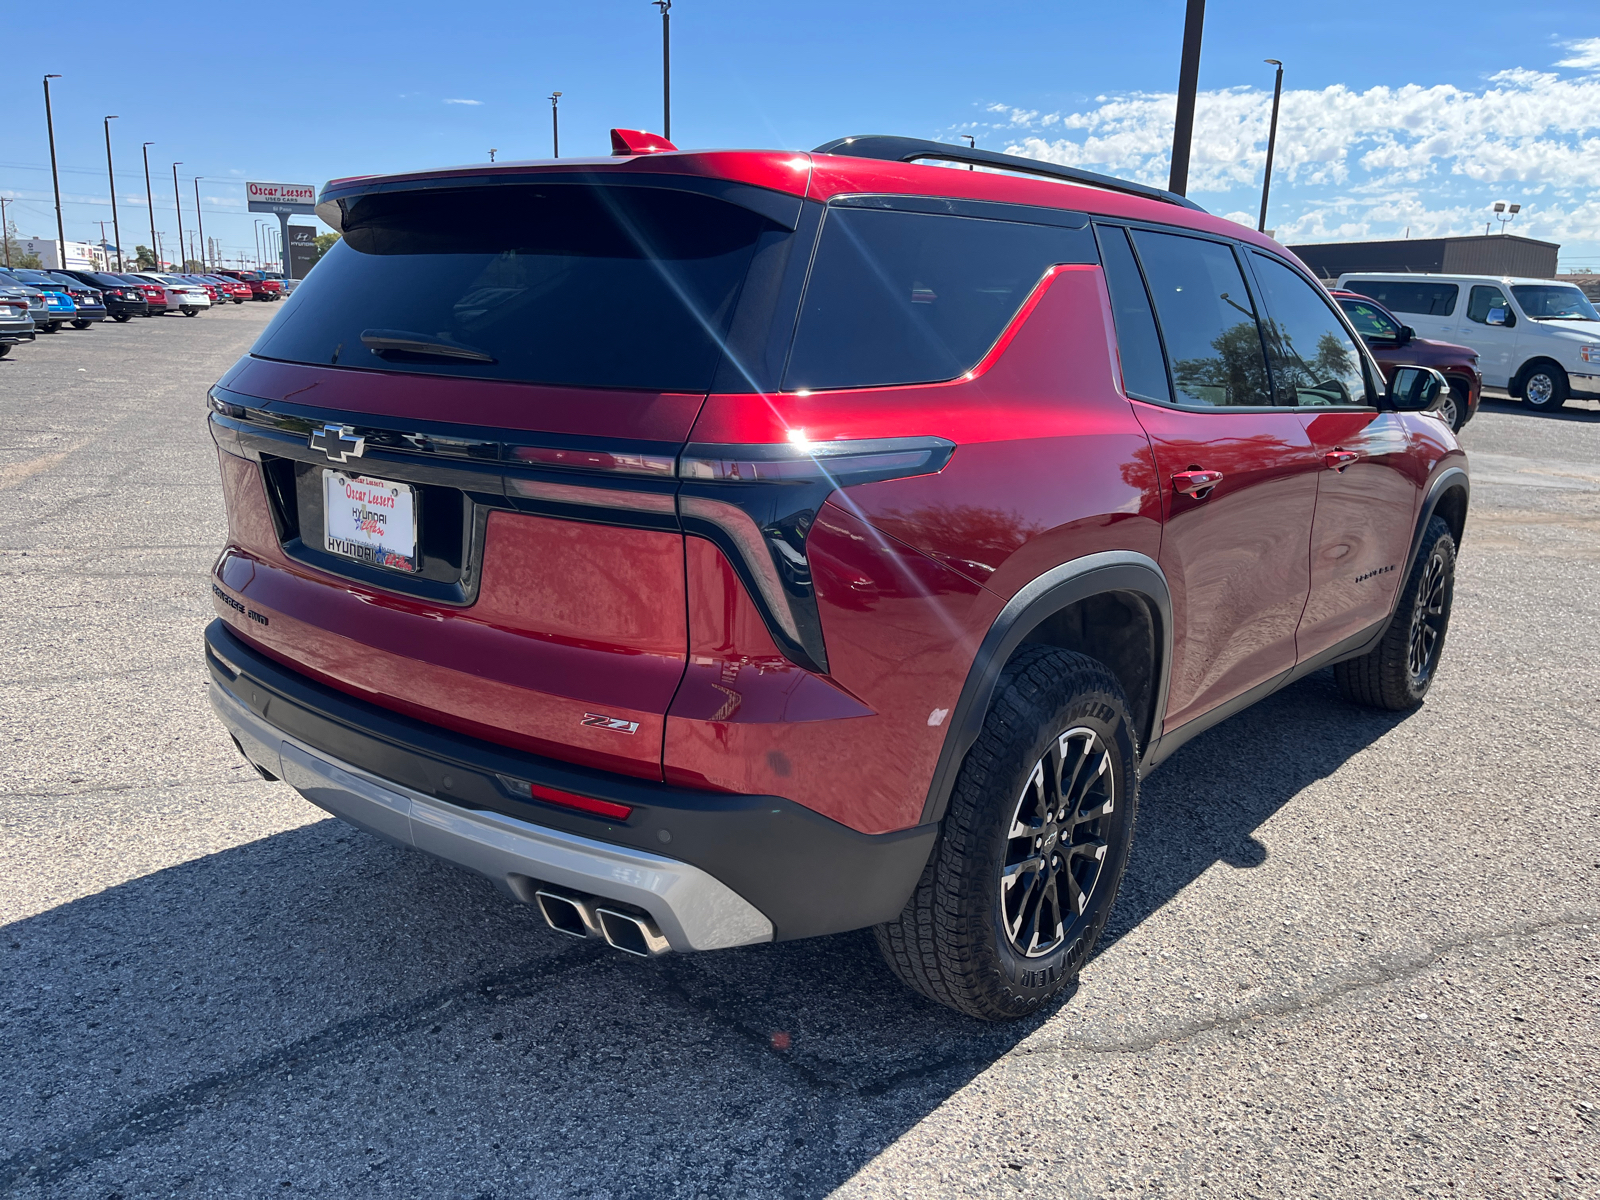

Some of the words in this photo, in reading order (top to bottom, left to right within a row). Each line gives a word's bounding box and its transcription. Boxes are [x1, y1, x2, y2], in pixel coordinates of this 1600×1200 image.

[250, 183, 278, 196] Oscar
[280, 187, 313, 198] Leeser's
[365, 478, 384, 488] Leeser's
[346, 483, 366, 502] Oscar
[367, 489, 395, 509] Leeser's
[352, 507, 387, 525] HYUNDAI
[328, 537, 374, 561] HYUNDAI
[247, 609, 269, 626] AWD
[580, 712, 640, 736] Z71
